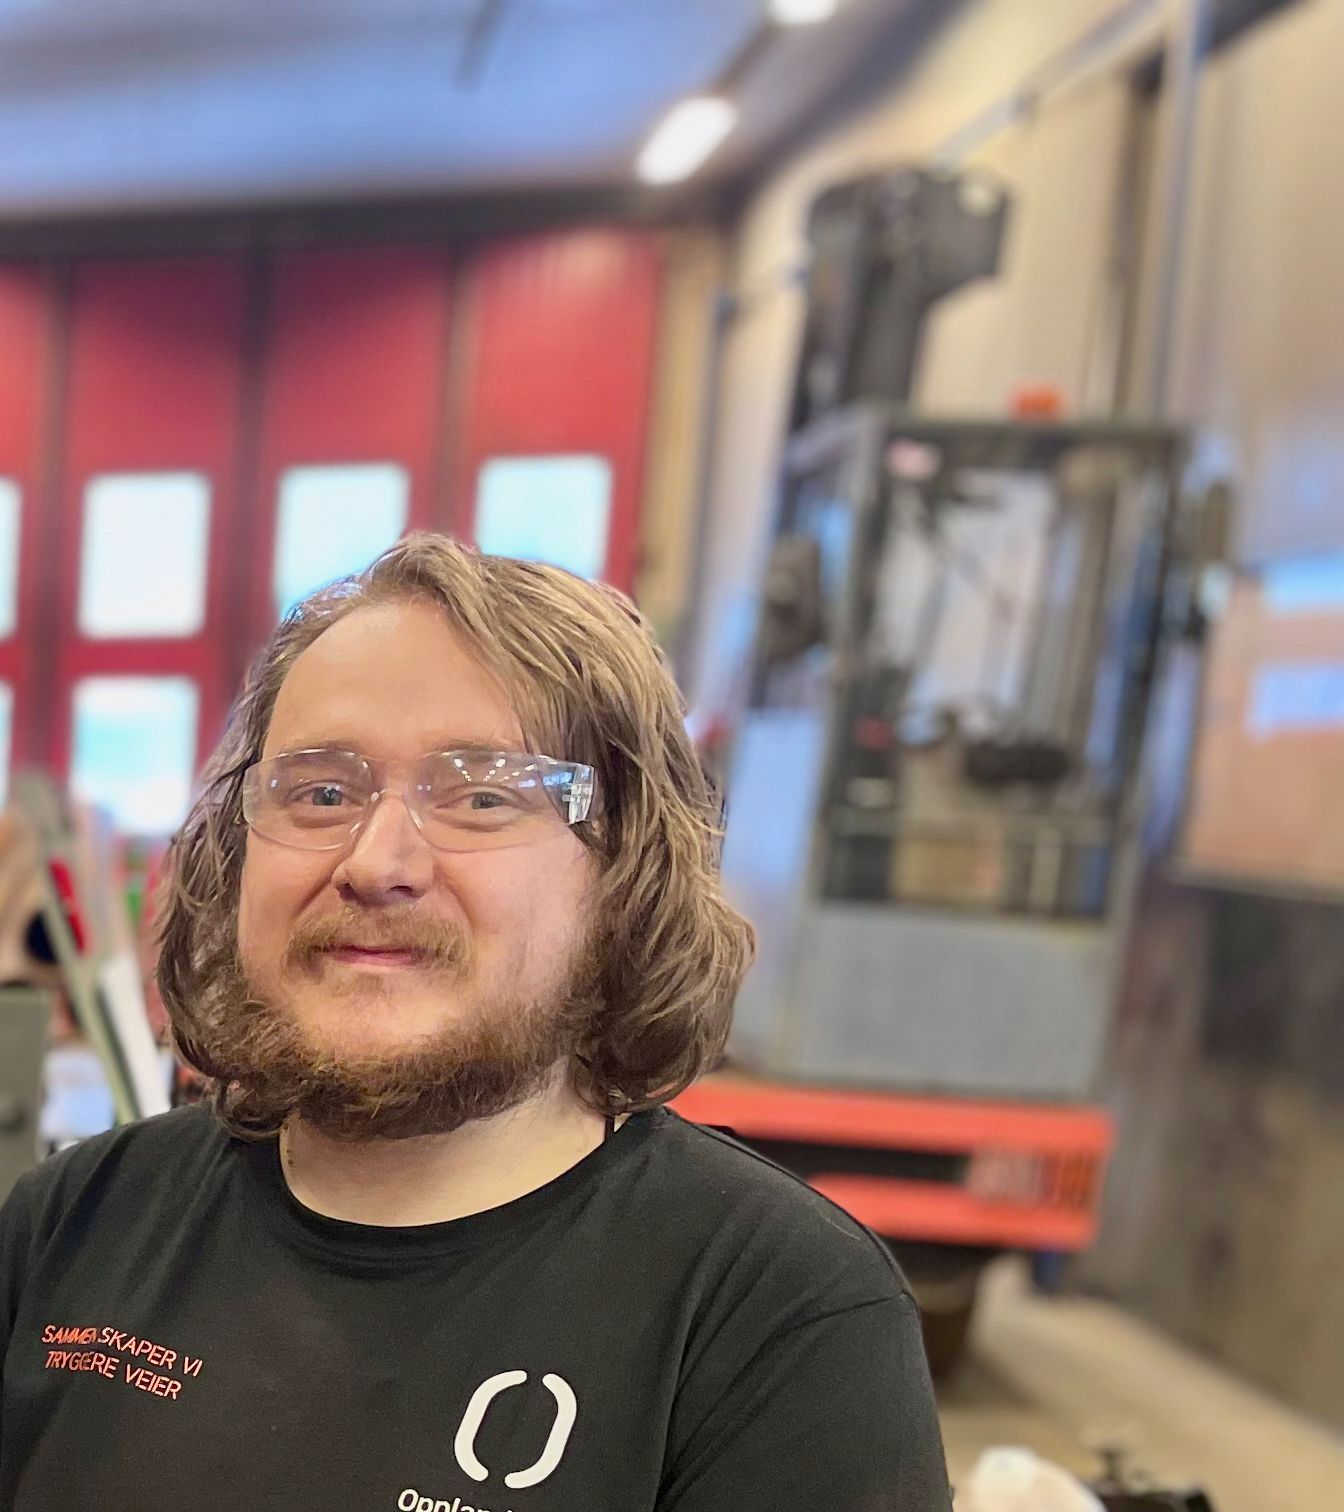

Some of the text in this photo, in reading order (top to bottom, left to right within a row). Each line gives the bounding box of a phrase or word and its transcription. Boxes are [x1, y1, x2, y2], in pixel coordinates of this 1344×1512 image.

[97, 1326, 178, 1370] SKAPER
[183, 1355, 204, 1378] VI
[125, 1363, 183, 1401] VEIER
